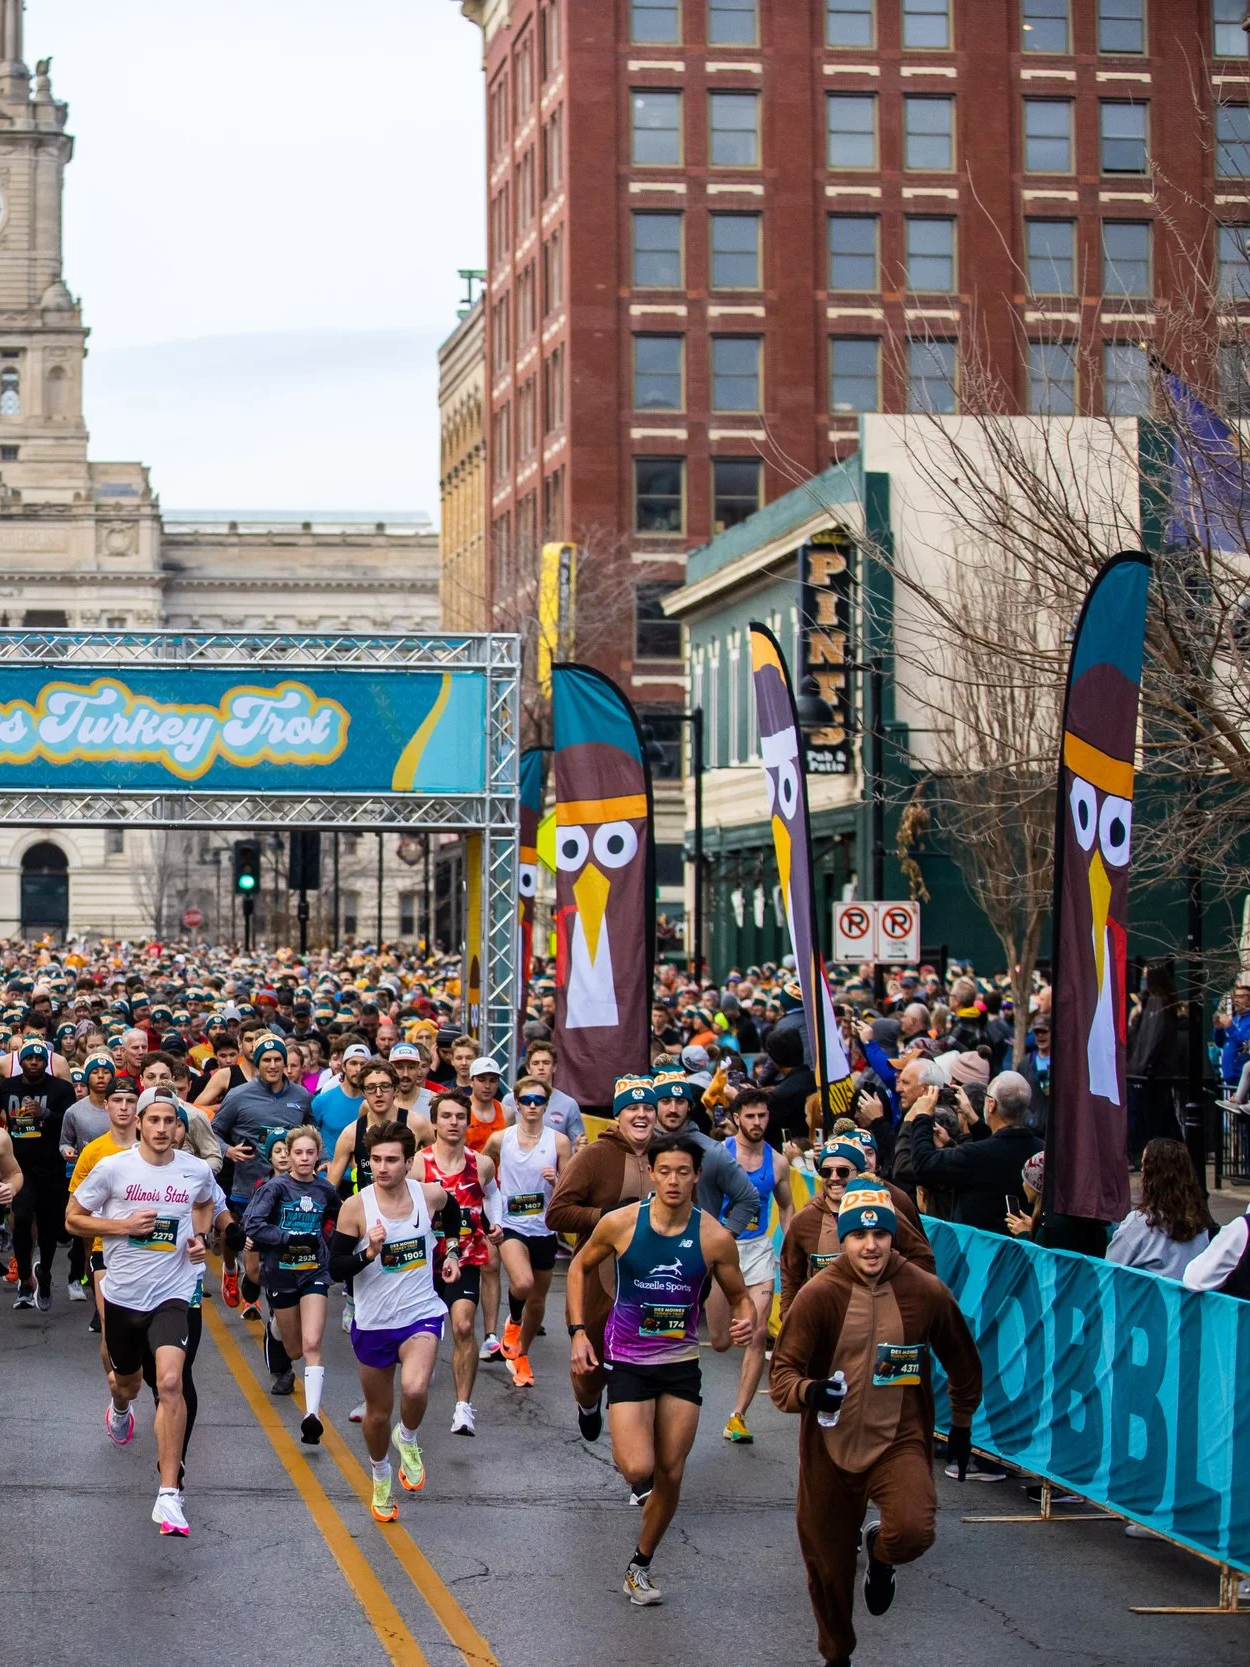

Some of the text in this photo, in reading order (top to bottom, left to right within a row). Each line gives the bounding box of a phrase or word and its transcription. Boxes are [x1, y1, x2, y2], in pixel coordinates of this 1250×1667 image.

[807, 551, 847, 746] PINTS
[38, 688, 213, 764] Turkey
[222, 691, 331, 747] Trot
[806, 750, 834, 762] Pub
[809, 761, 845, 773] Patio
[123, 1183, 190, 1204] Illinois State
[843, 1190, 893, 1209] DSM
[524, 1202, 542, 1210] 1407
[152, 1231, 174, 1241] 2279
[298, 1254, 317, 1262] 2926
[403, 1250, 424, 1261] 1905
[633, 1279, 692, 1293] Gazelle Sports
[900, 1363, 920, 1373] 4311
[924, 1223, 1250, 1565] OBBL
